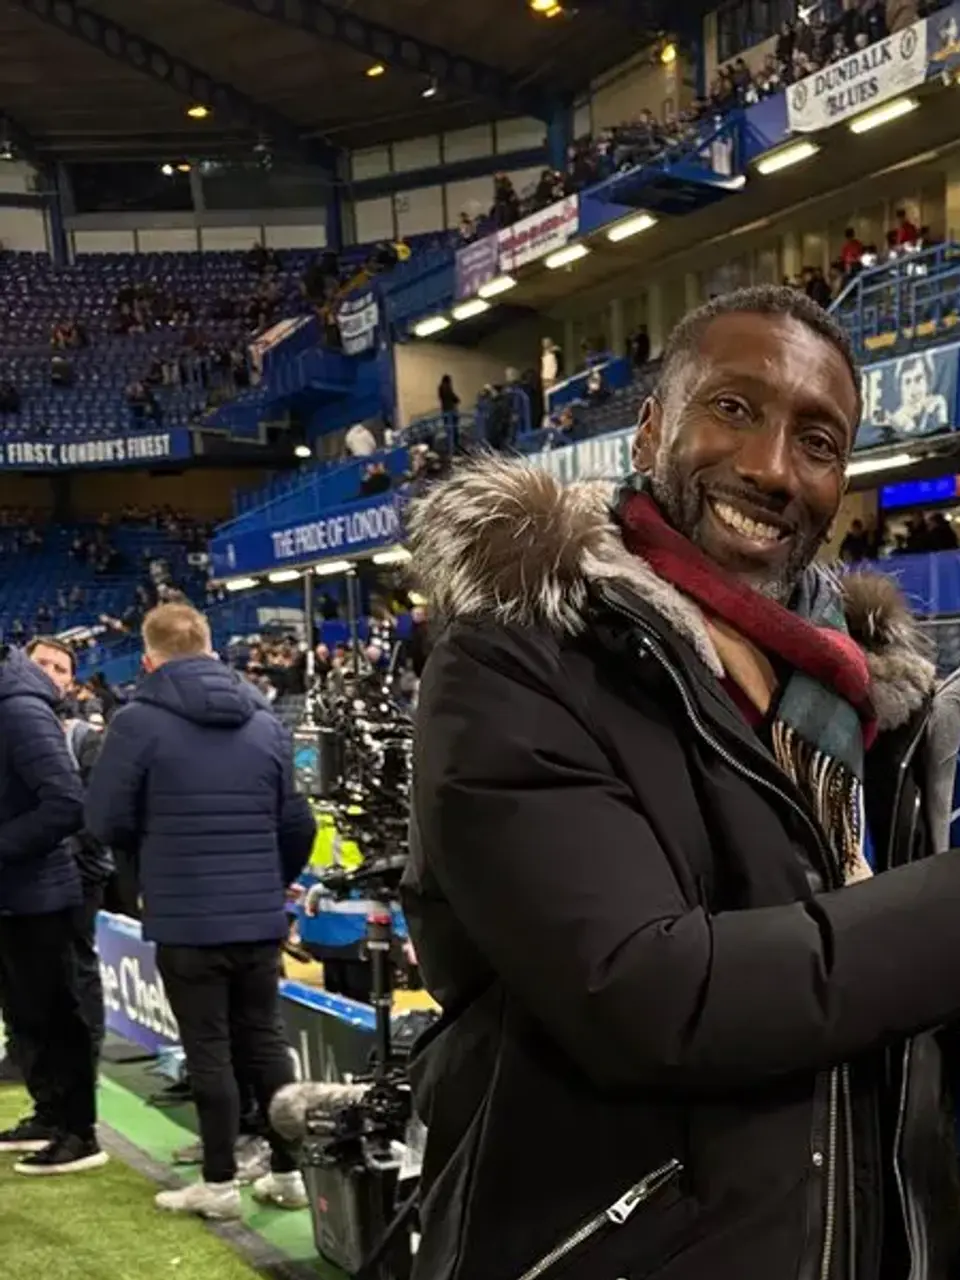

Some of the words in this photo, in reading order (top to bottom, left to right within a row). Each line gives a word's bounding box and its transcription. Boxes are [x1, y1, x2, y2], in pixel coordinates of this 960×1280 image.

[814, 40, 892, 97] DUNDALK
[827, 76, 879, 117] BLUES
[60, 438, 125, 465] LONDON'S
[127, 433, 170, 459] FINEST
[271, 528, 295, 560] THE
[295, 520, 327, 554] PRIDE
[327, 515, 345, 548] OF
[345, 504, 398, 544] LONDON
